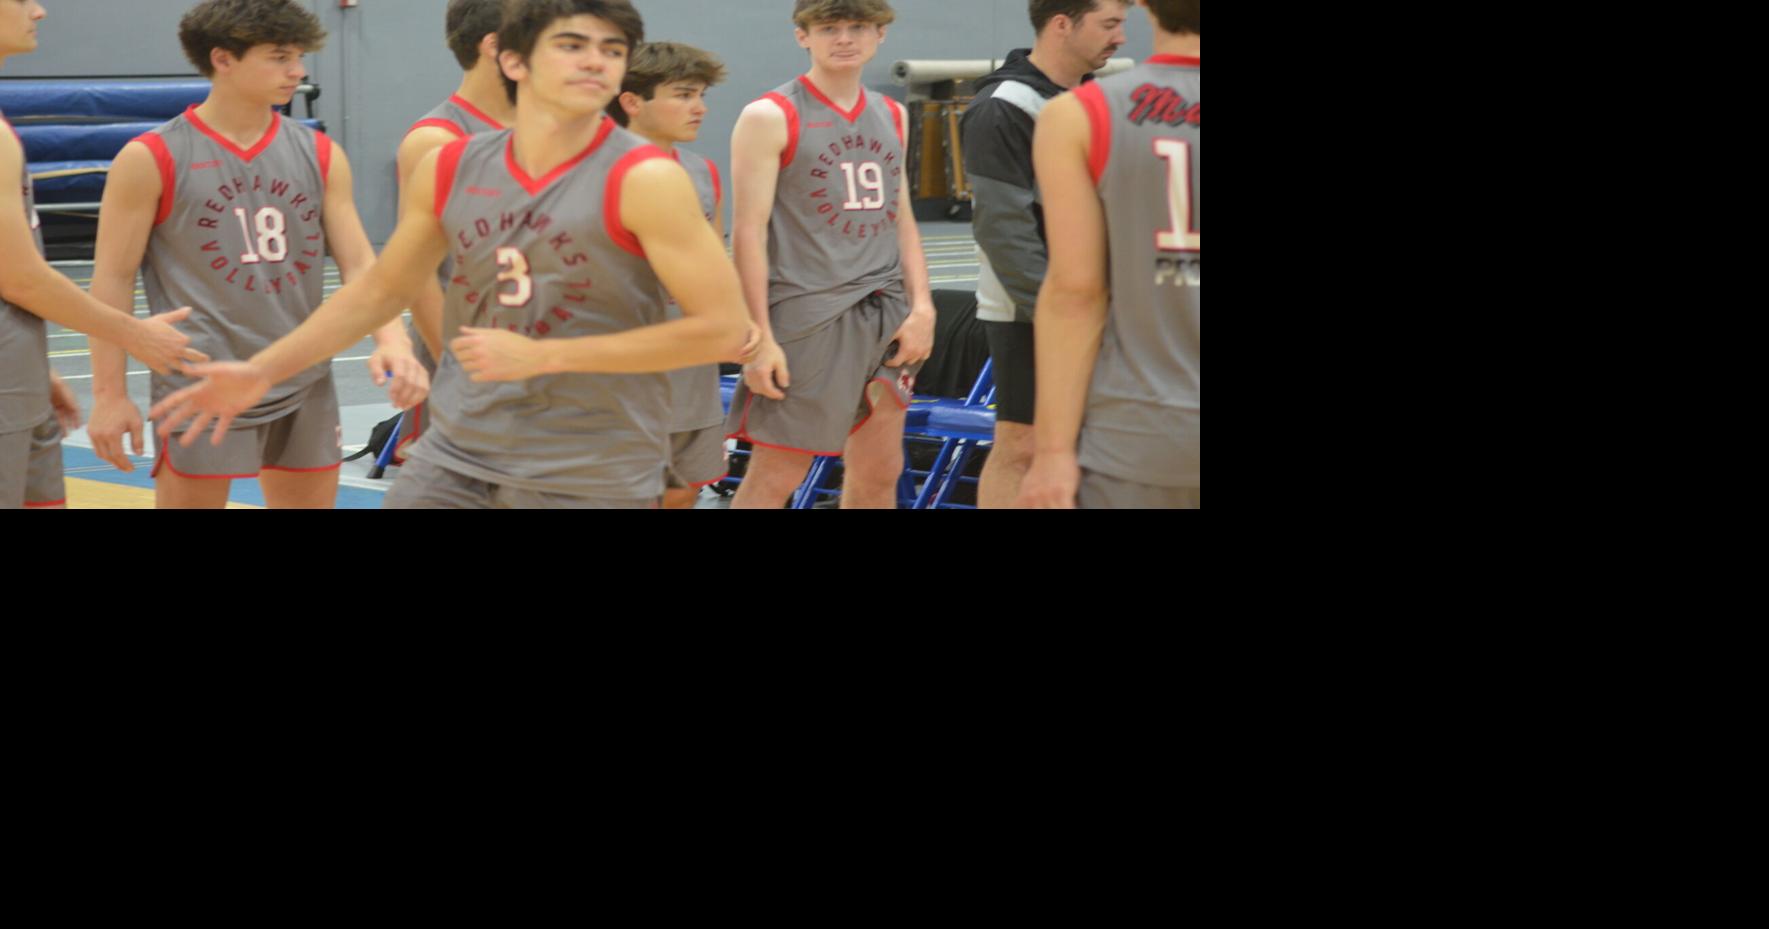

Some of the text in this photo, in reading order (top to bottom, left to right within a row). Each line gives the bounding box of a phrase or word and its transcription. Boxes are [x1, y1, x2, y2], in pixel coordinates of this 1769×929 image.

[809, 135, 901, 179] REDHAWKS
[197, 175, 319, 229] REDHAWKS
[809, 187, 900, 238] VOLLEYA
[840, 160, 885, 211] 19
[233, 205, 289, 264] 18
[455, 210, 588, 266] EDHAWKS
[200, 232, 320, 295] VOLLYBALL
[495, 245, 532, 308] 3
